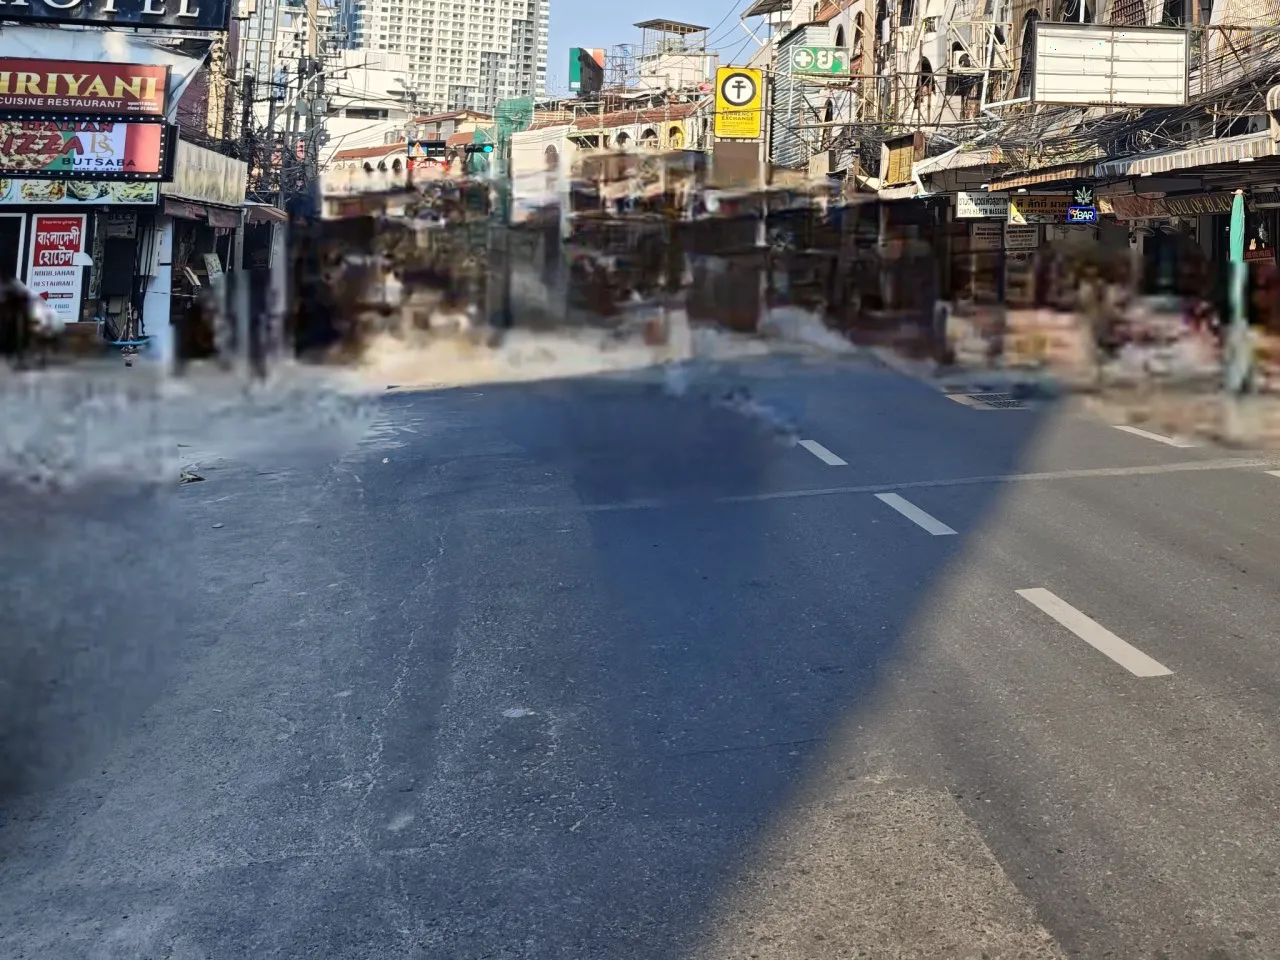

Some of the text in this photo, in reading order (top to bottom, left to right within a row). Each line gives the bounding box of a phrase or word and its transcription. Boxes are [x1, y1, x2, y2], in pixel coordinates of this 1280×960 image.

[816, 49, 848, 70] ยา
[0, 97, 122, 109] CUISINE RESTAURANT
[21, 120, 115, 133] ITALIAN
[61, 157, 136, 167] BUTSABA
[1167, 198, 1193, 216] SOUL
[1190, 197, 1204, 214] OF
[37, 226, 81, 246] বাংলাদেশী
[39, 244, 74, 265] হোটেল
